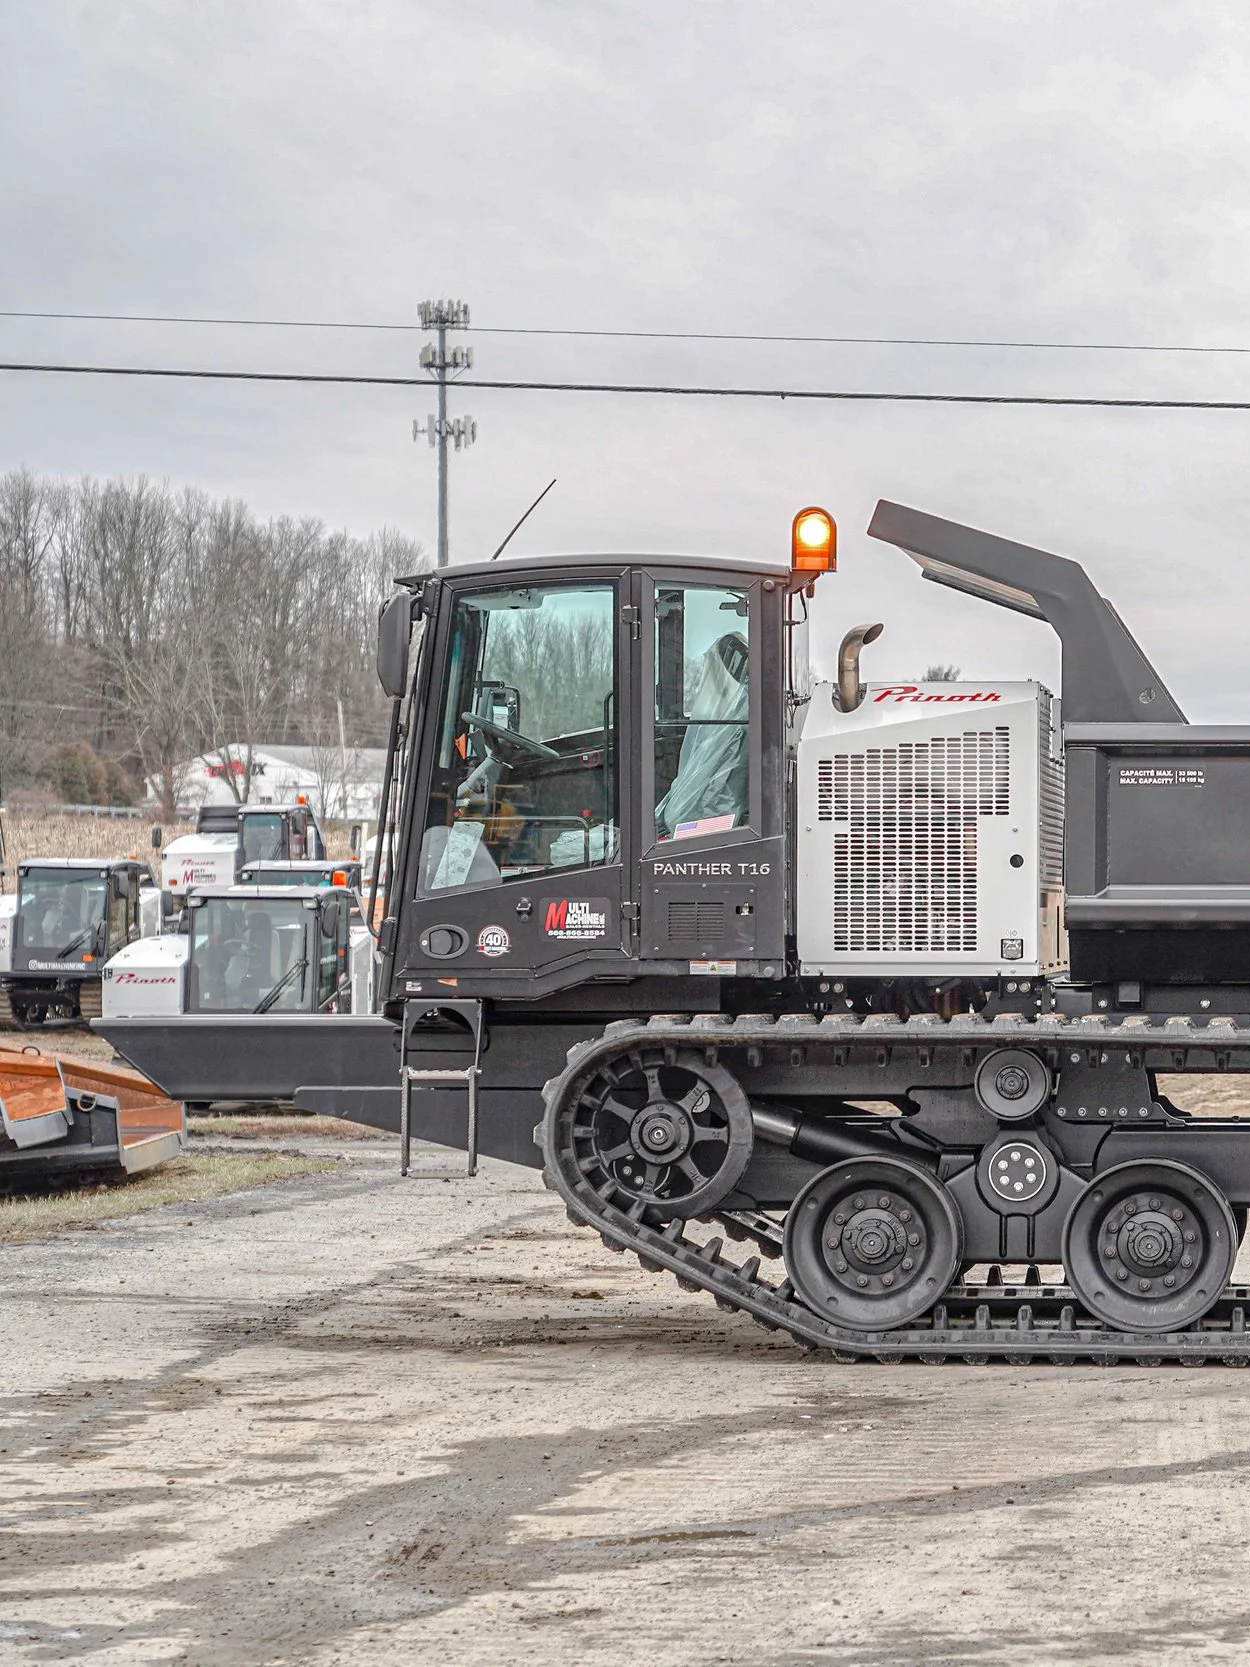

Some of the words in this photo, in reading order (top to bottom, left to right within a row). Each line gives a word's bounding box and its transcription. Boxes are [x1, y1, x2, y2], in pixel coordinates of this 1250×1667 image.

[870, 686, 1001, 703] Prinoth
[1120, 769, 1154, 777] CAPACITÉ
[653, 863, 732, 875] PANTHER
[738, 863, 771, 875] T16
[568, 902, 589, 913] ULTI
[566, 913, 600, 925] ACHINE
[485, 933, 502, 946] 40
[113, 973, 177, 985] Prinoth
